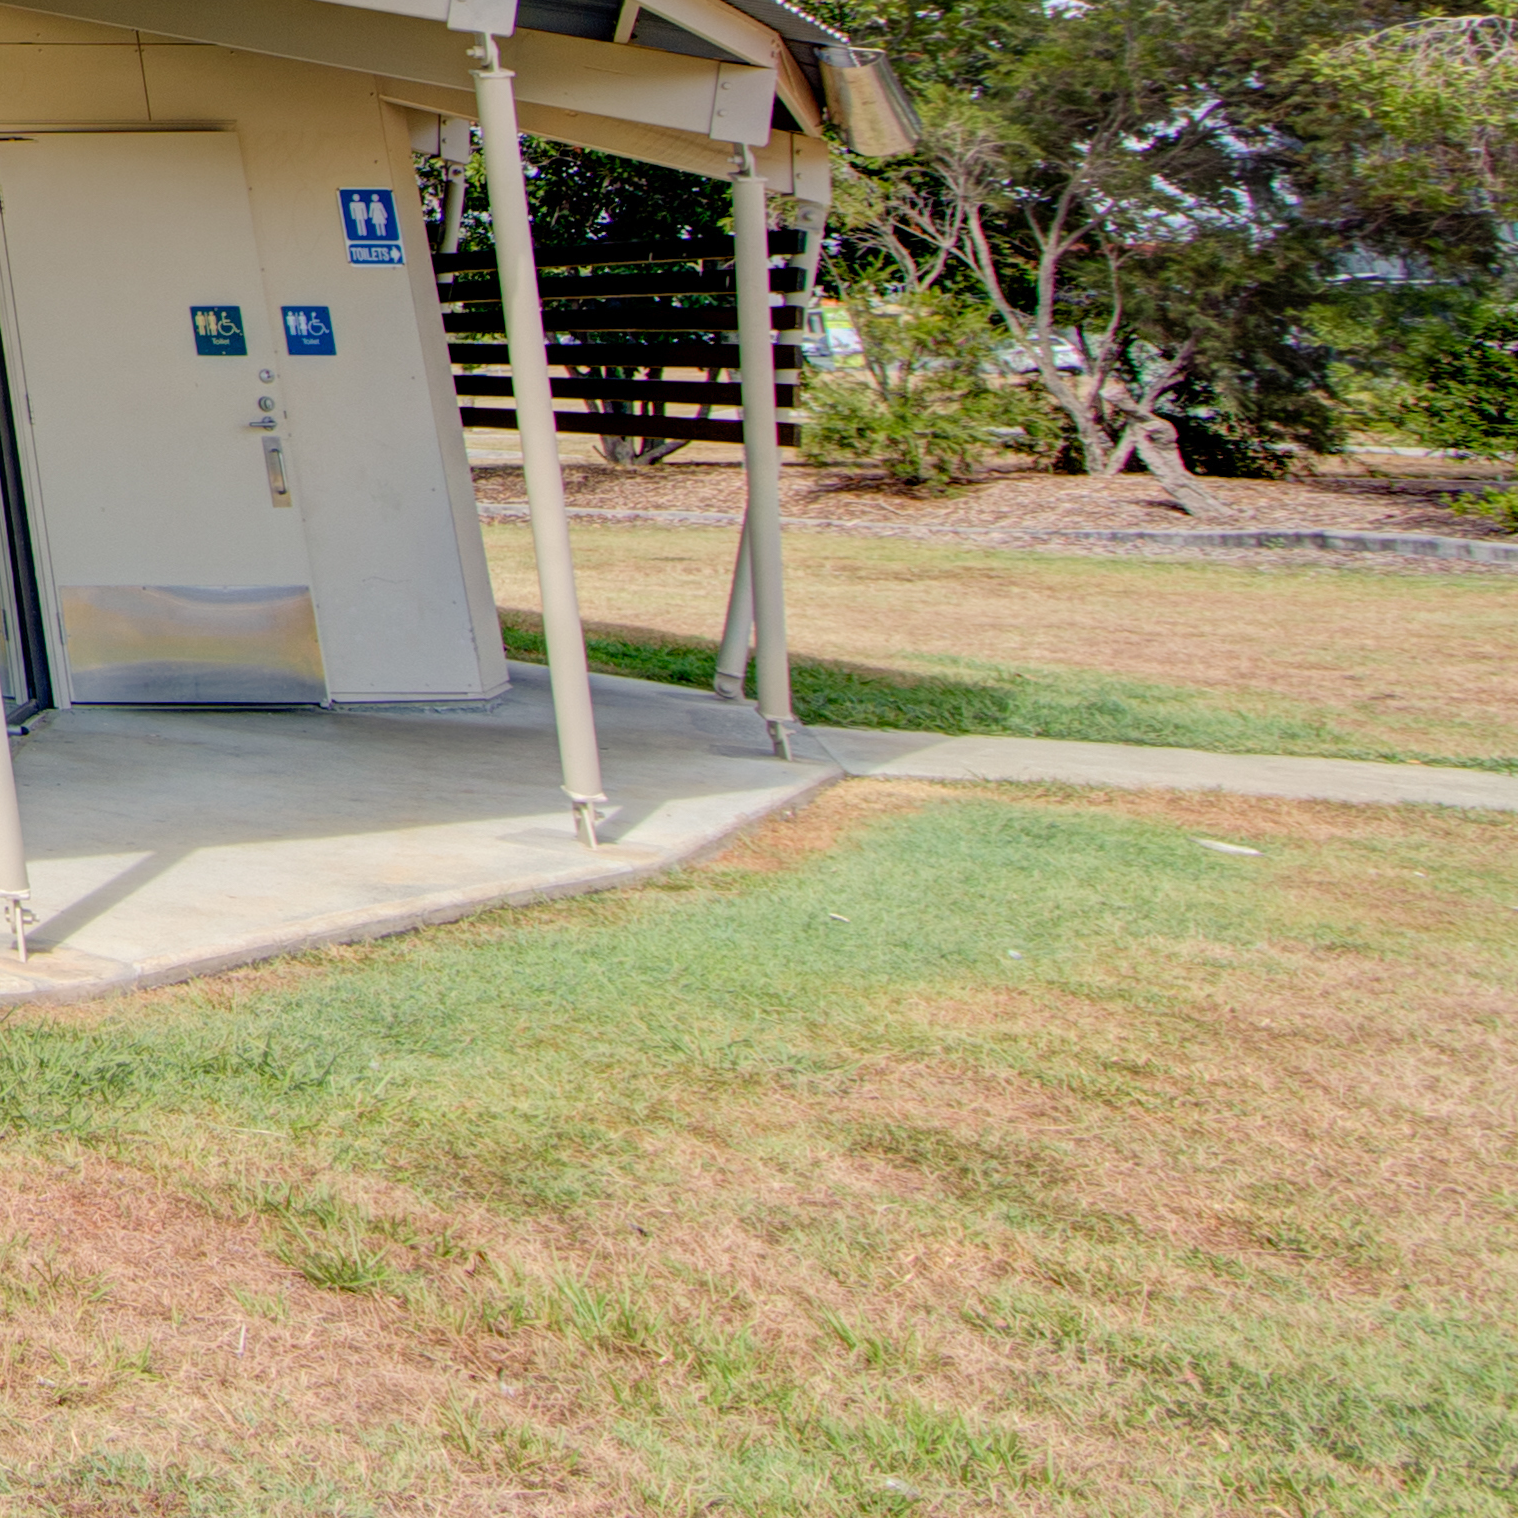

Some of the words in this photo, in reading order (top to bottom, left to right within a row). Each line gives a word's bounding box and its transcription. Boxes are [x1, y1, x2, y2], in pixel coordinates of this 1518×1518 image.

[350, 246, 390, 262] TOILETS
[211, 337, 230, 346] Toilet
[301, 337, 320, 346] Toilet
